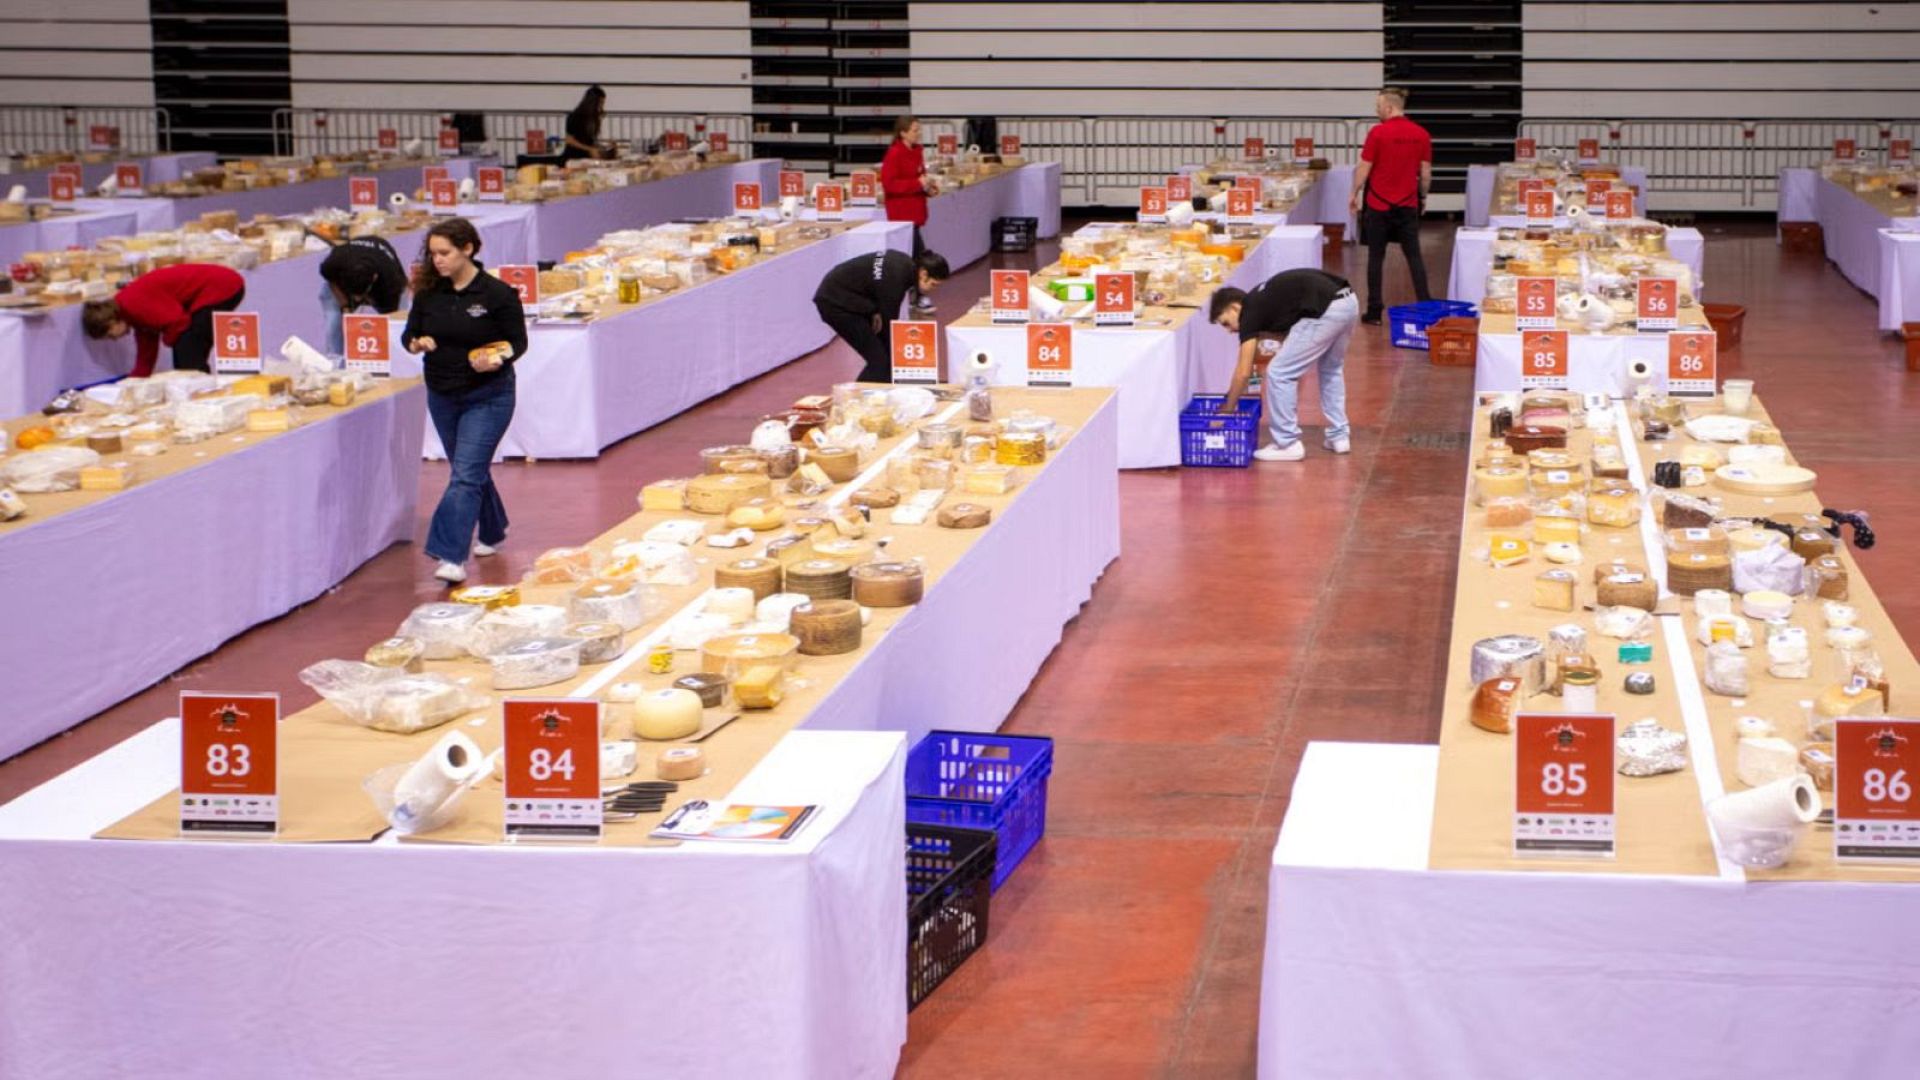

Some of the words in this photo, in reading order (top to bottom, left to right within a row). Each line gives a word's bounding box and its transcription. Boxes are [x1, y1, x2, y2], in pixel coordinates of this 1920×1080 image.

[1148, 200, 1160, 210] 53
[1534, 204, 1547, 214] 55
[1613, 204, 1626, 214] 56
[510, 284, 529, 299] 2
[1002, 289, 1019, 303] 53
[1106, 292, 1123, 305] 54
[1527, 296, 1545, 310] 55
[1648, 297, 1667, 311] 56
[227, 335, 246, 351] 81
[357, 337, 379, 353] 82
[904, 344, 925, 360] 83
[1039, 346, 1060, 361] 84
[1534, 352, 1555, 367] 85
[1680, 355, 1702, 371] 86
[207, 744, 250, 776] 83
[530, 748, 575, 780] 84
[1542, 763, 1587, 795] 85
[1863, 768, 1911, 802] 86
